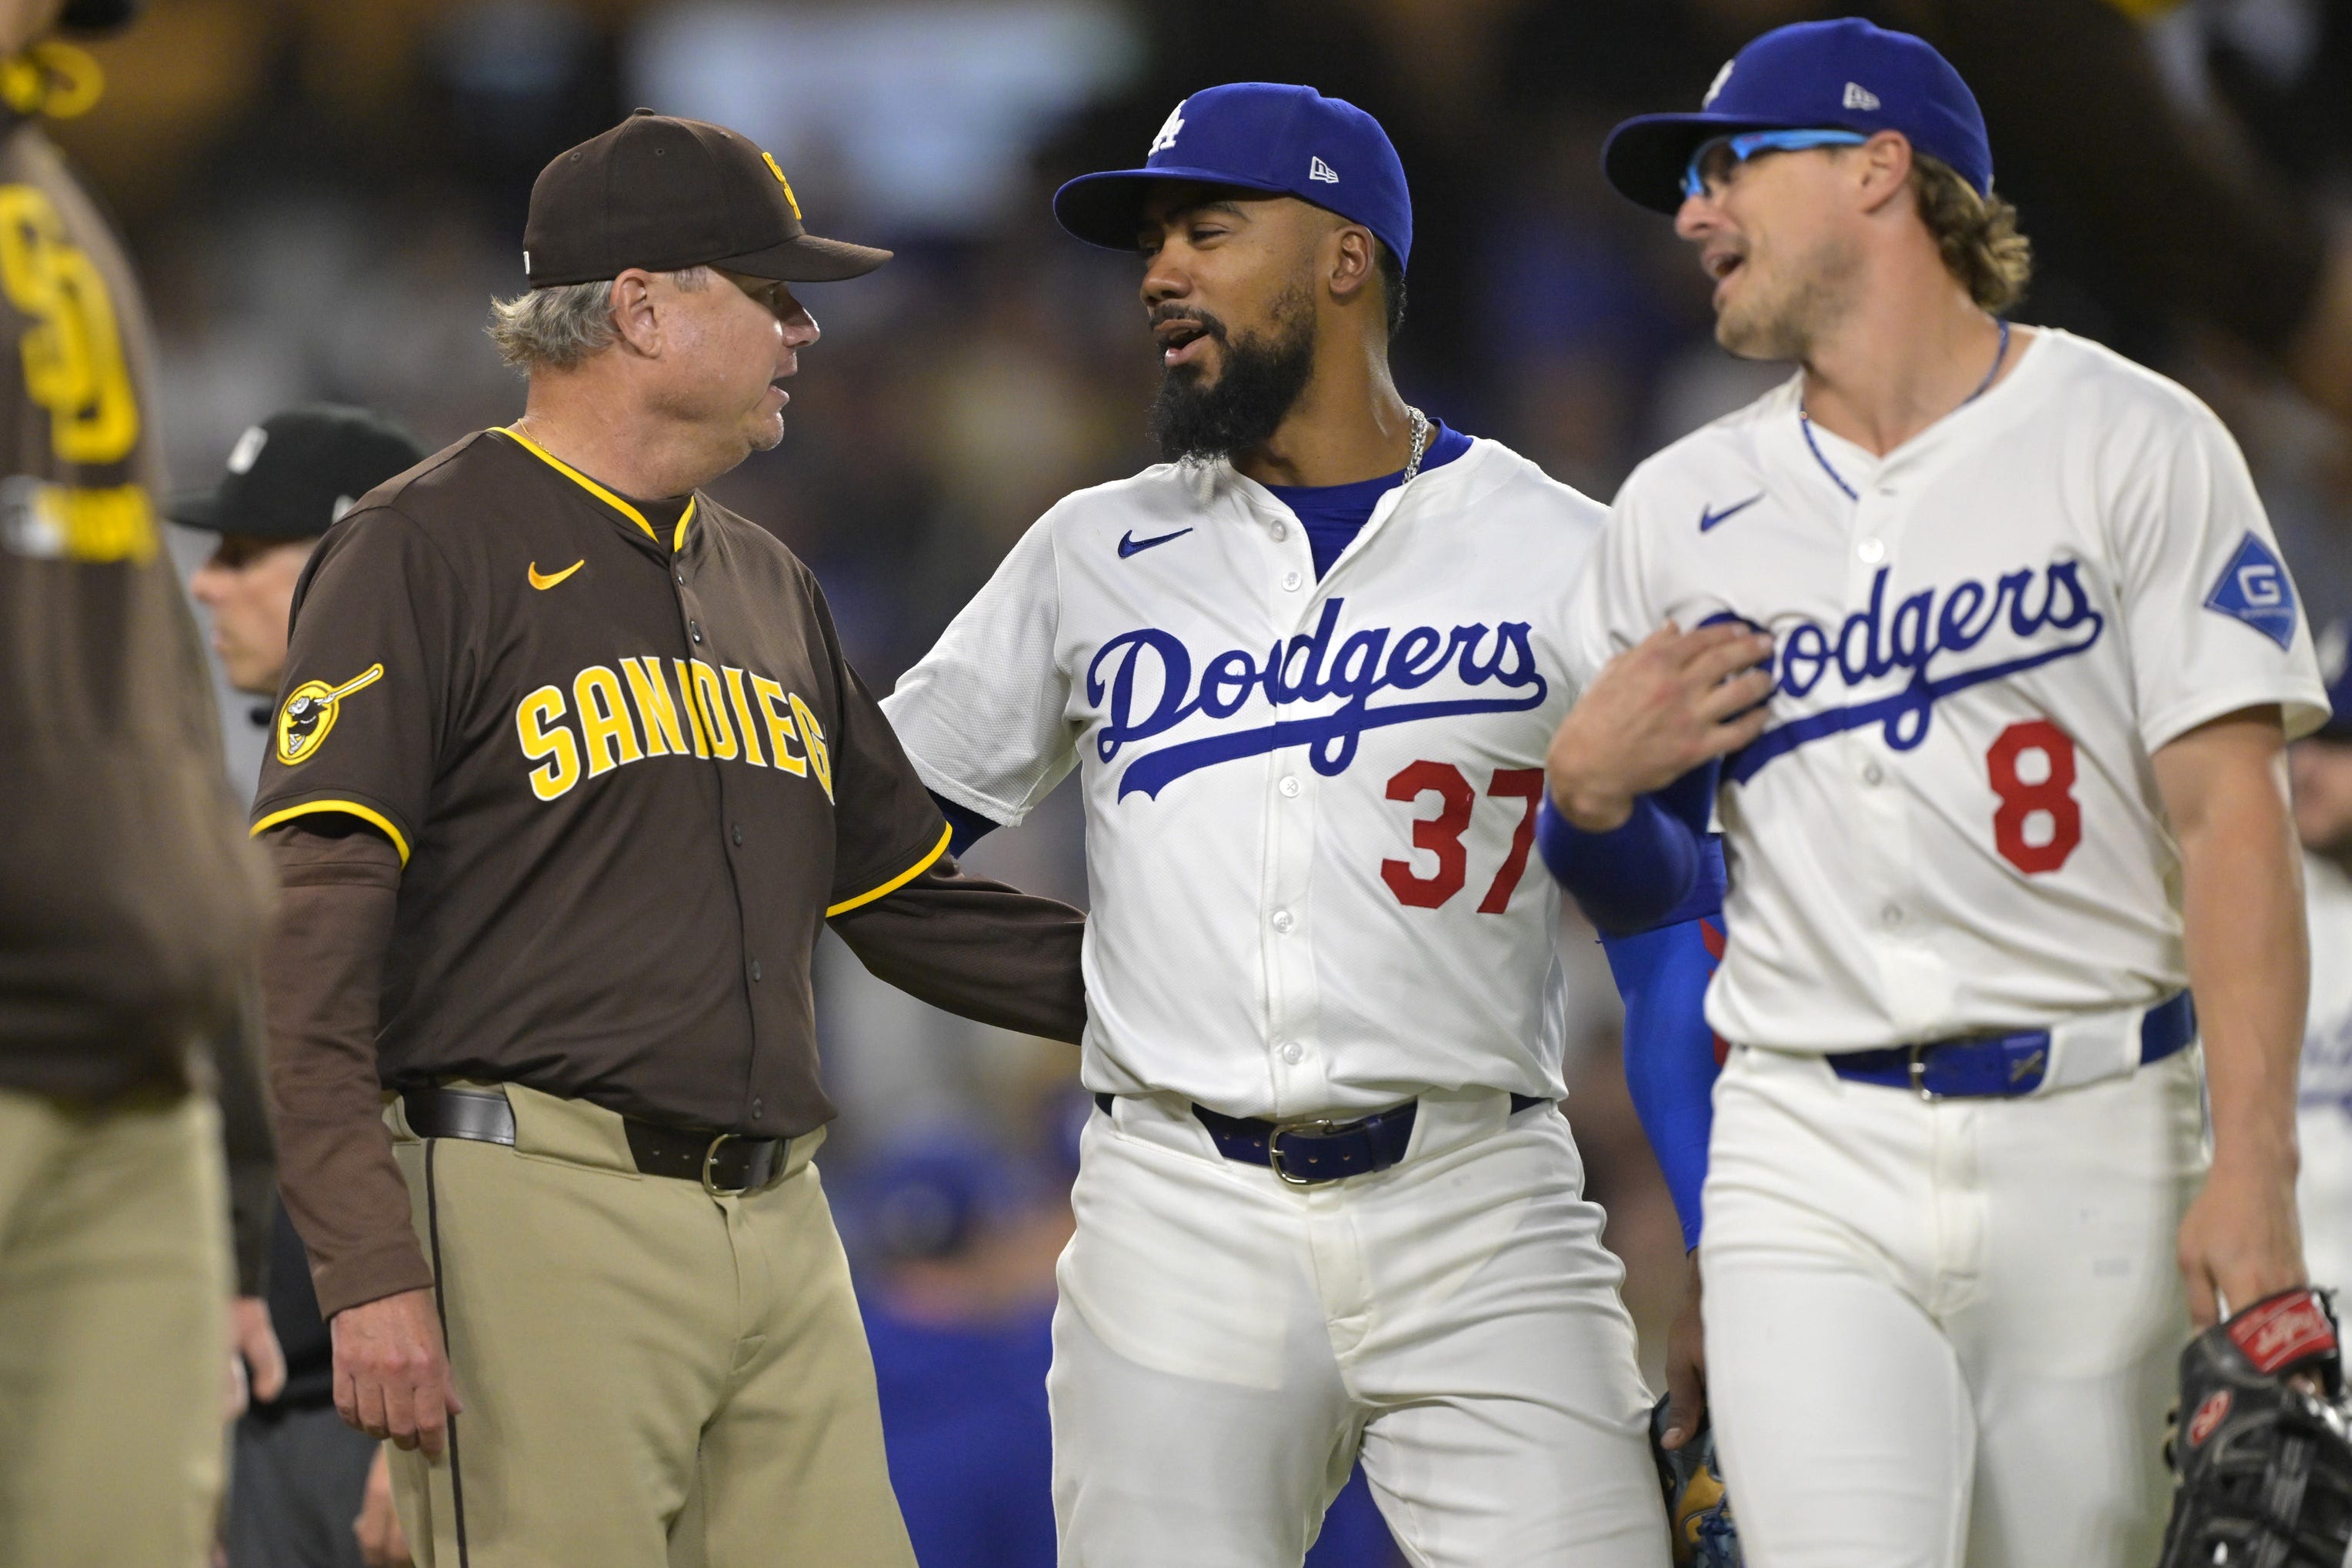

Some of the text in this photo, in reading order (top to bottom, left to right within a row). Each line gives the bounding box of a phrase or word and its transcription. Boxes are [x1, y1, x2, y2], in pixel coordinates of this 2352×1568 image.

[2237, 565, 2281, 606] G
[515, 656, 836, 806] SAN DIEG
[1087, 597, 1547, 806] Dodgers
[1381, 759, 1545, 916] 37
[1986, 716, 2083, 877] 8
